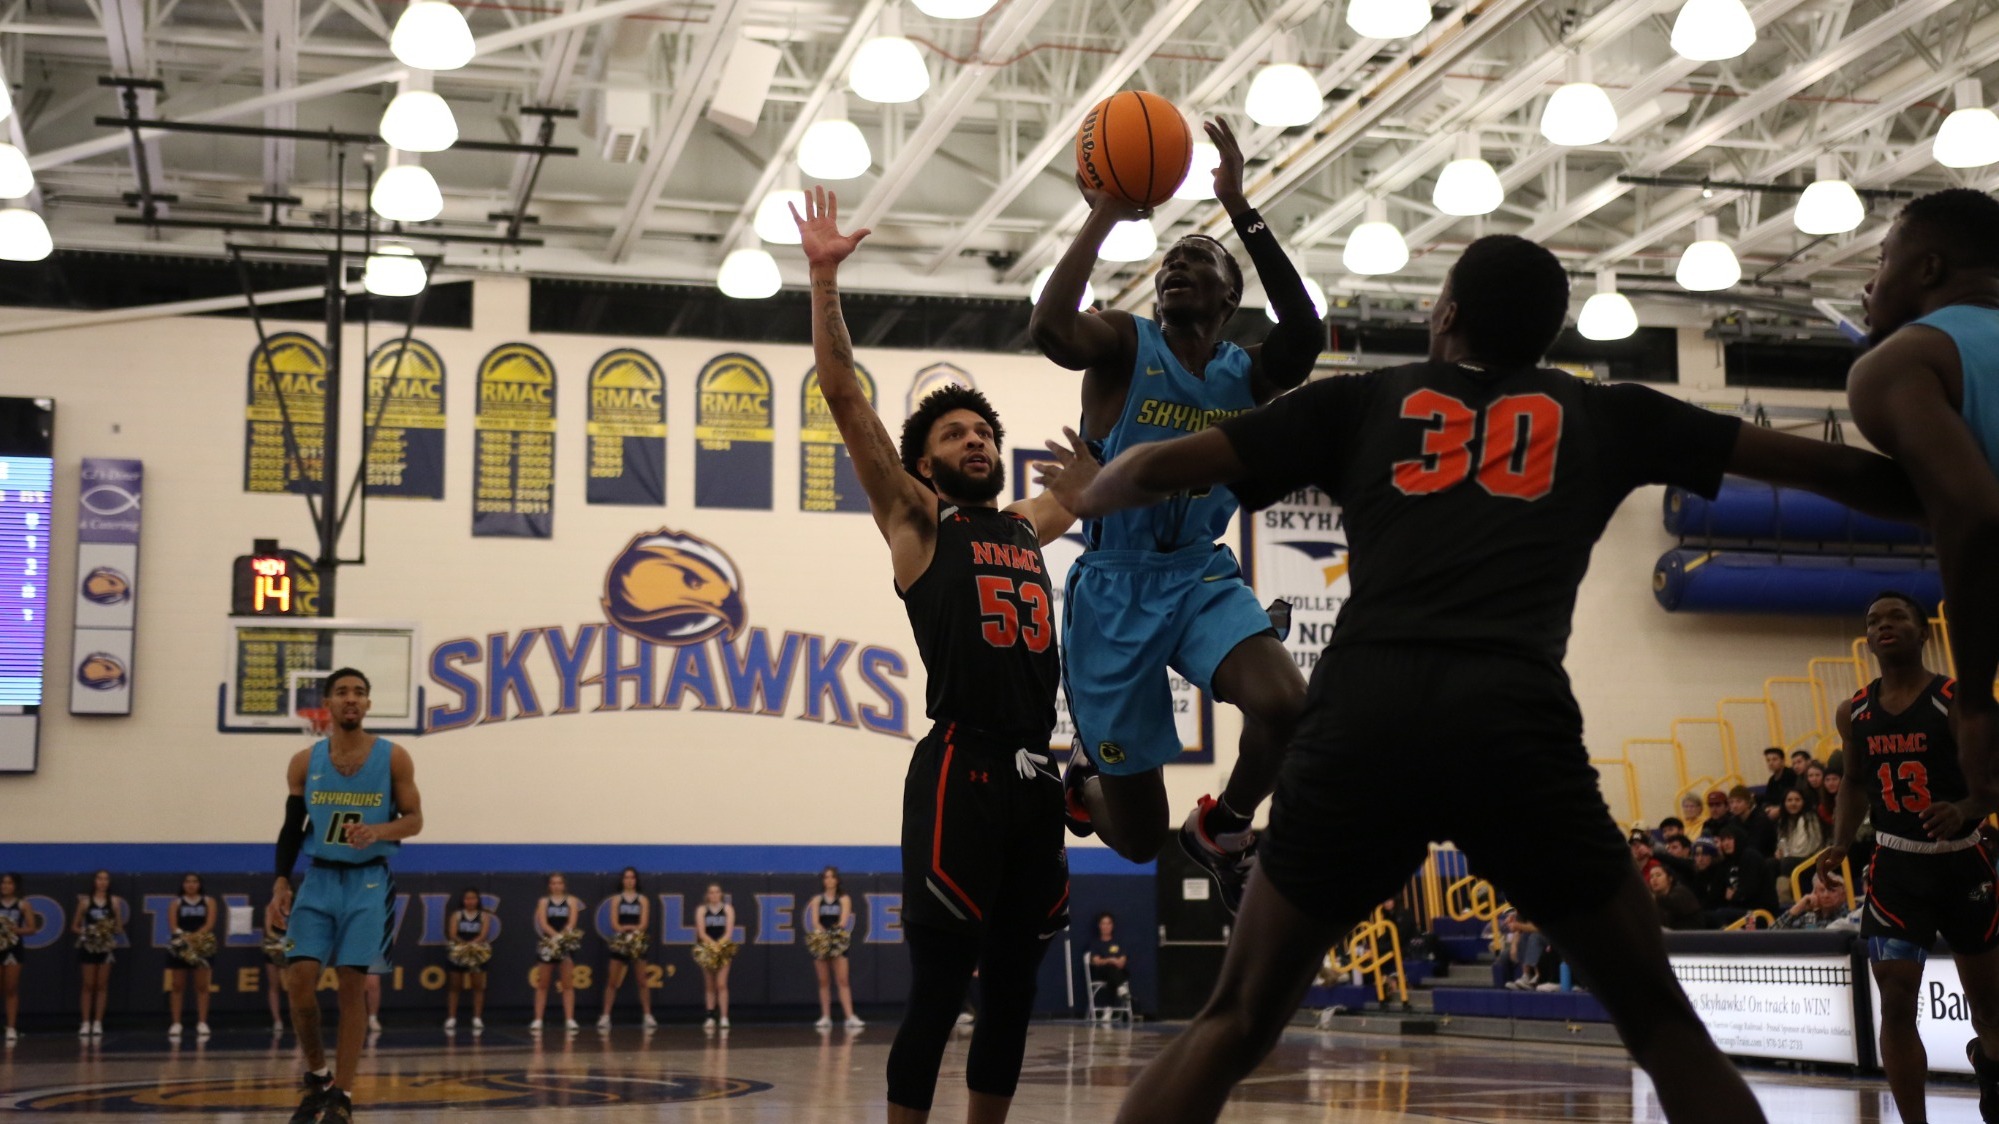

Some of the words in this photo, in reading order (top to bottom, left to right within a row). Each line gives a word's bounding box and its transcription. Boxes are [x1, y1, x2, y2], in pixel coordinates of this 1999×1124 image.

[1081, 109, 1104, 188] Wilson
[253, 373, 326, 395] RMAC
[369, 379, 441, 400] RMAC
[482, 383, 552, 404] RMAC
[592, 388, 662, 409] RMAC
[701, 393, 769, 415] RMAC
[1137, 399, 1253, 433] SKYHA
[1391, 387, 1564, 502] 30
[367, 474, 402, 486] 2010
[516, 502, 549, 513] 2011
[971, 541, 1041, 574] NNMC
[255, 575, 291, 612] 14
[975, 574, 1051, 653] 53
[424, 622, 917, 743] SKYHAWKS
[1867, 732, 1929, 756] NNMC
[310, 790, 384, 807] SKYHAWKS
[1877, 760, 1932, 813] 13
[1700, 993, 1746, 1017] Skyhawks!
[1749, 995, 1763, 1013] On
[1764, 996, 1789, 1014] track
[1791, 998, 1801, 1014] to
[1803, 996, 1831, 1016] WIN!
